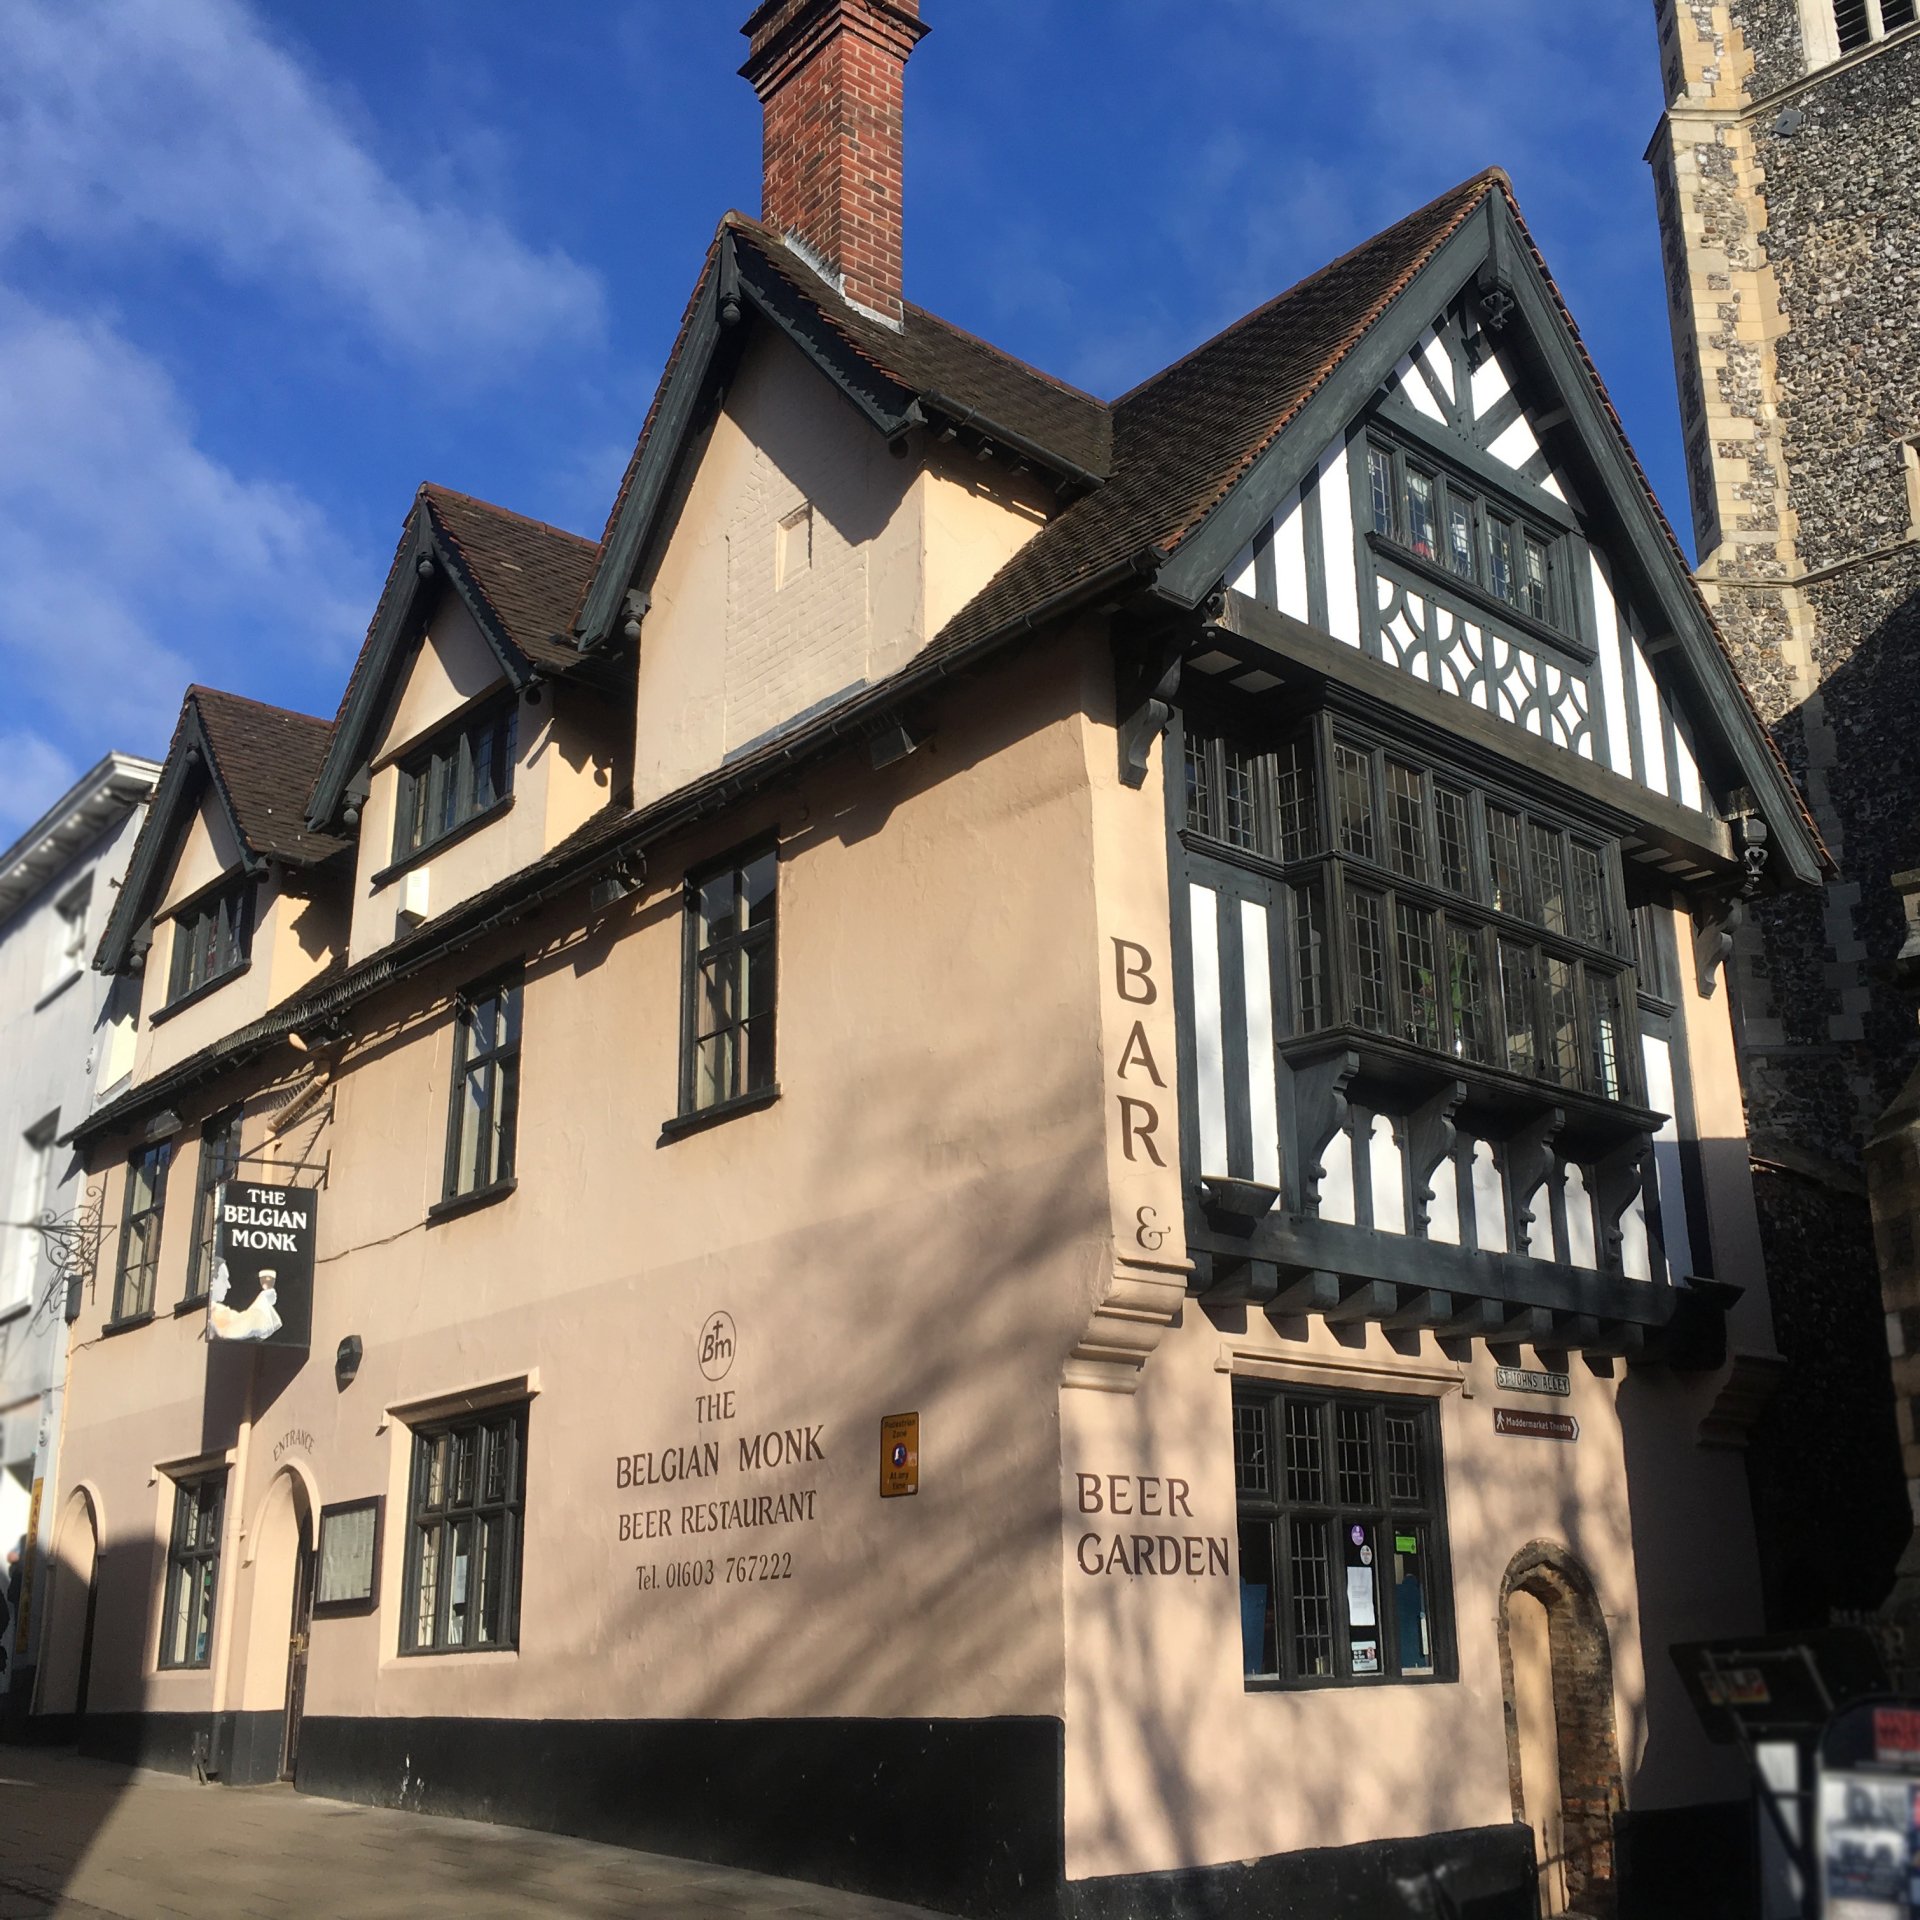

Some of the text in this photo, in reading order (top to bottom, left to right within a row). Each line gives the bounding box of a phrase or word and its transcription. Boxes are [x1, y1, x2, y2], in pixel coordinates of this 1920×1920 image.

[1110, 936, 1171, 1251] BAR &
[247, 1188, 286, 1206] THE
[224, 1204, 307, 1230] BELGIAN
[232, 1229, 298, 1252] MONK
[1498, 1369, 1568, 1392] ST JOHNS ALLEY
[695, 1390, 737, 1424] THE
[1506, 1416, 1549, 1430] Maddermarket
[273, 1429, 315, 1462] ENTRANCE
[616, 1424, 826, 1489] BELGIAN MONK
[1075, 1472, 1194, 1518] BEER
[618, 1489, 818, 1542] BEER RESTAURANT
[636, 1551, 793, 1591] Tel. 01603 767222
[1077, 1532, 1229, 1576] GARDEN
